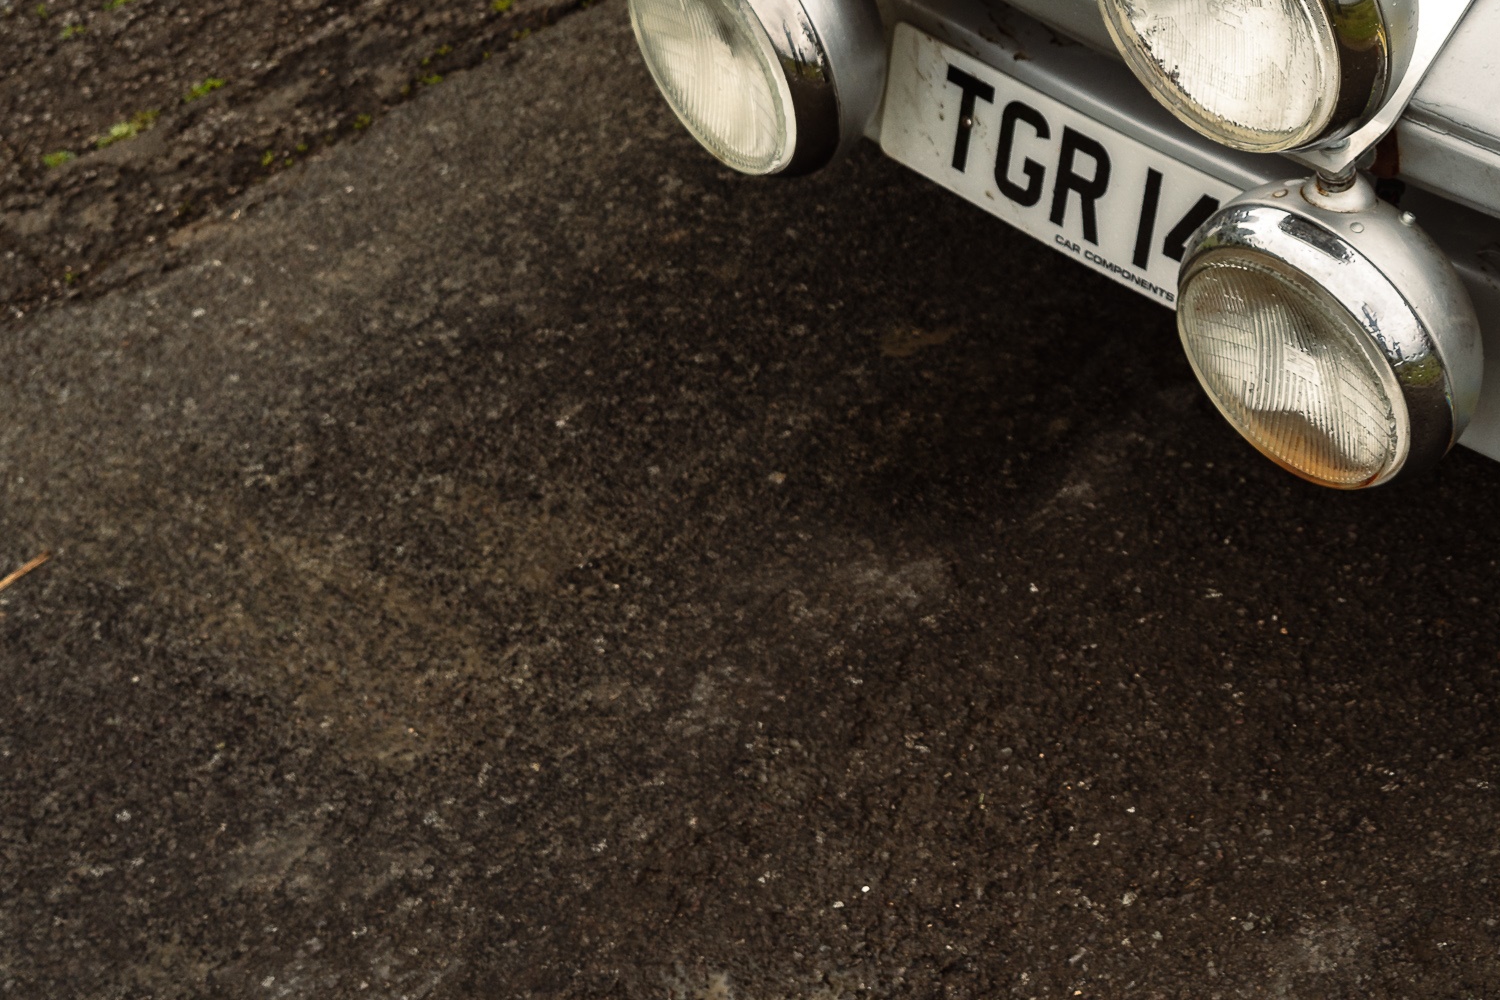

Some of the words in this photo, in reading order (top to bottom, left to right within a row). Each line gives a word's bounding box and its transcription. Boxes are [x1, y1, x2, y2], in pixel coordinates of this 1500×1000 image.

[946, 63, 1112, 247] TGR
[1055, 234, 1081, 256] CAR
[1084, 249, 1175, 303] COMPONENTS
